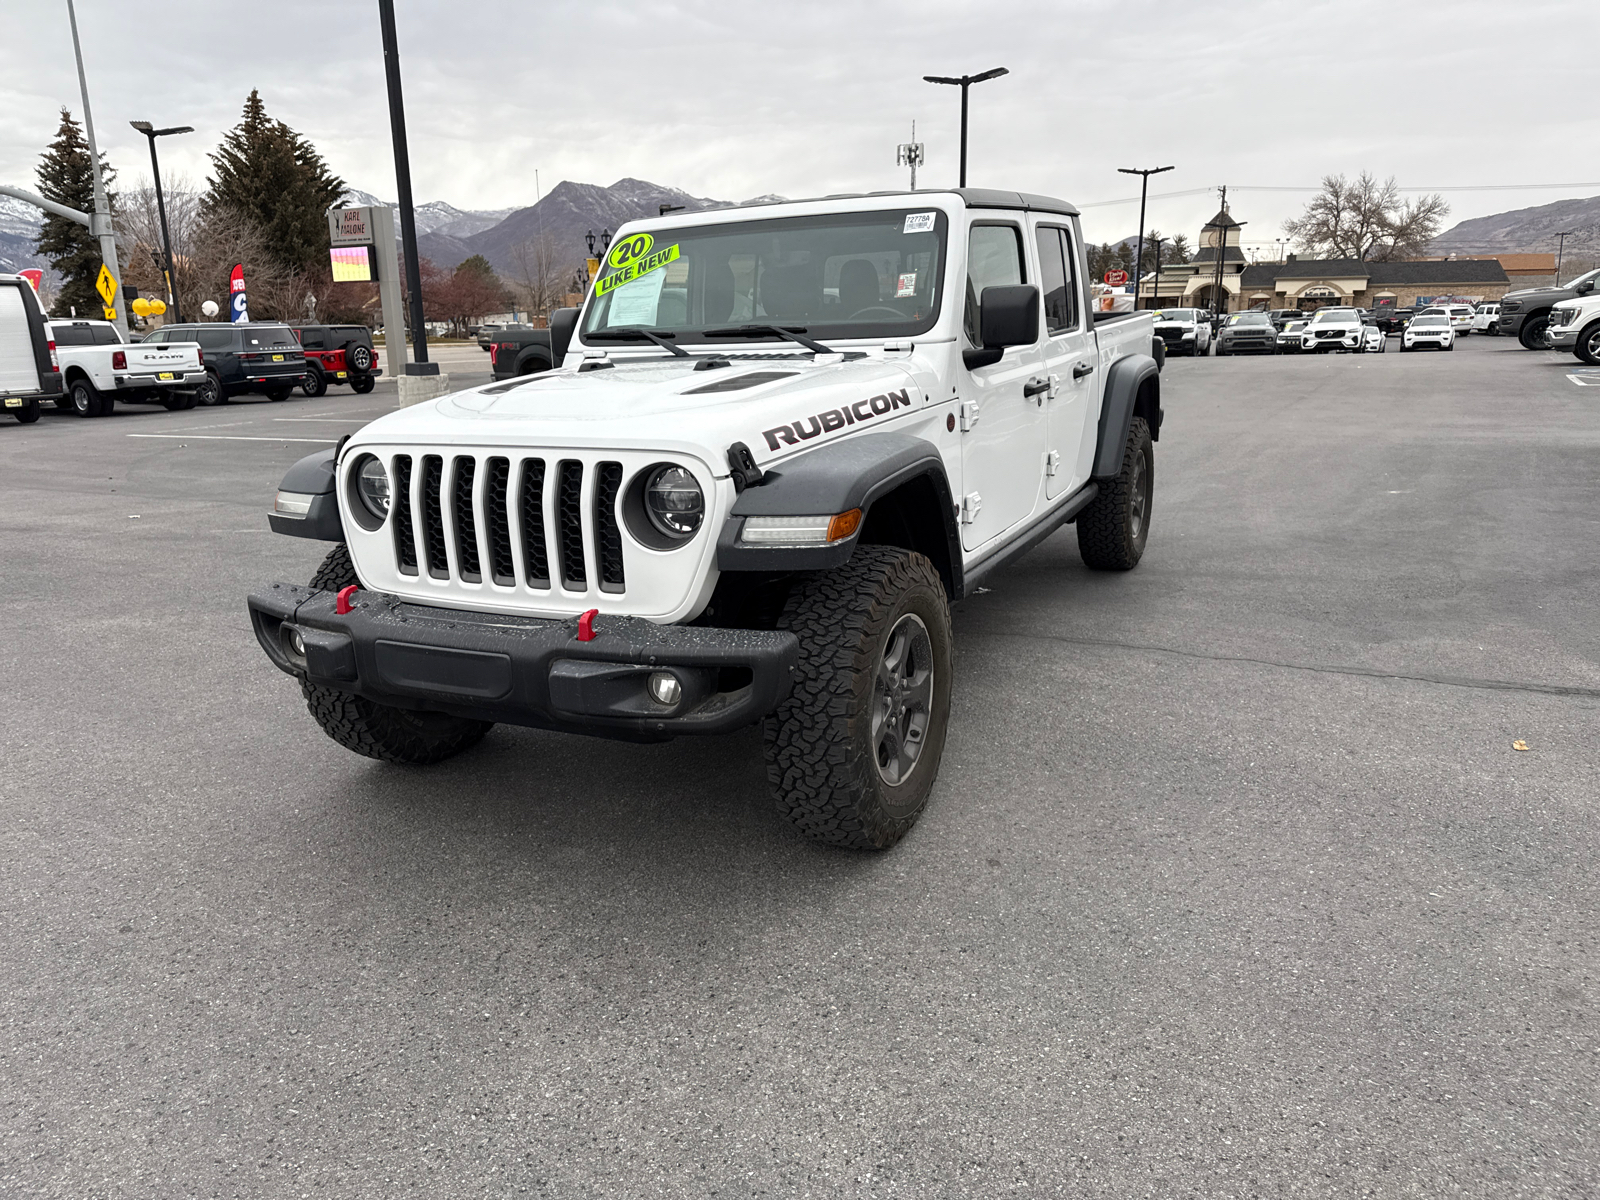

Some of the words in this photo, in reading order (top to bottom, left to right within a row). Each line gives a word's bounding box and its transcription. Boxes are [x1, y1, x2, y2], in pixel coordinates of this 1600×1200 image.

[340, 223, 366, 235] MALONE
[344, 211, 360, 222] KARL
[617, 236, 646, 265] 20
[602, 266, 633, 291] LIKE
[637, 247, 672, 275] NEW
[762, 388, 911, 451] RUBICON
